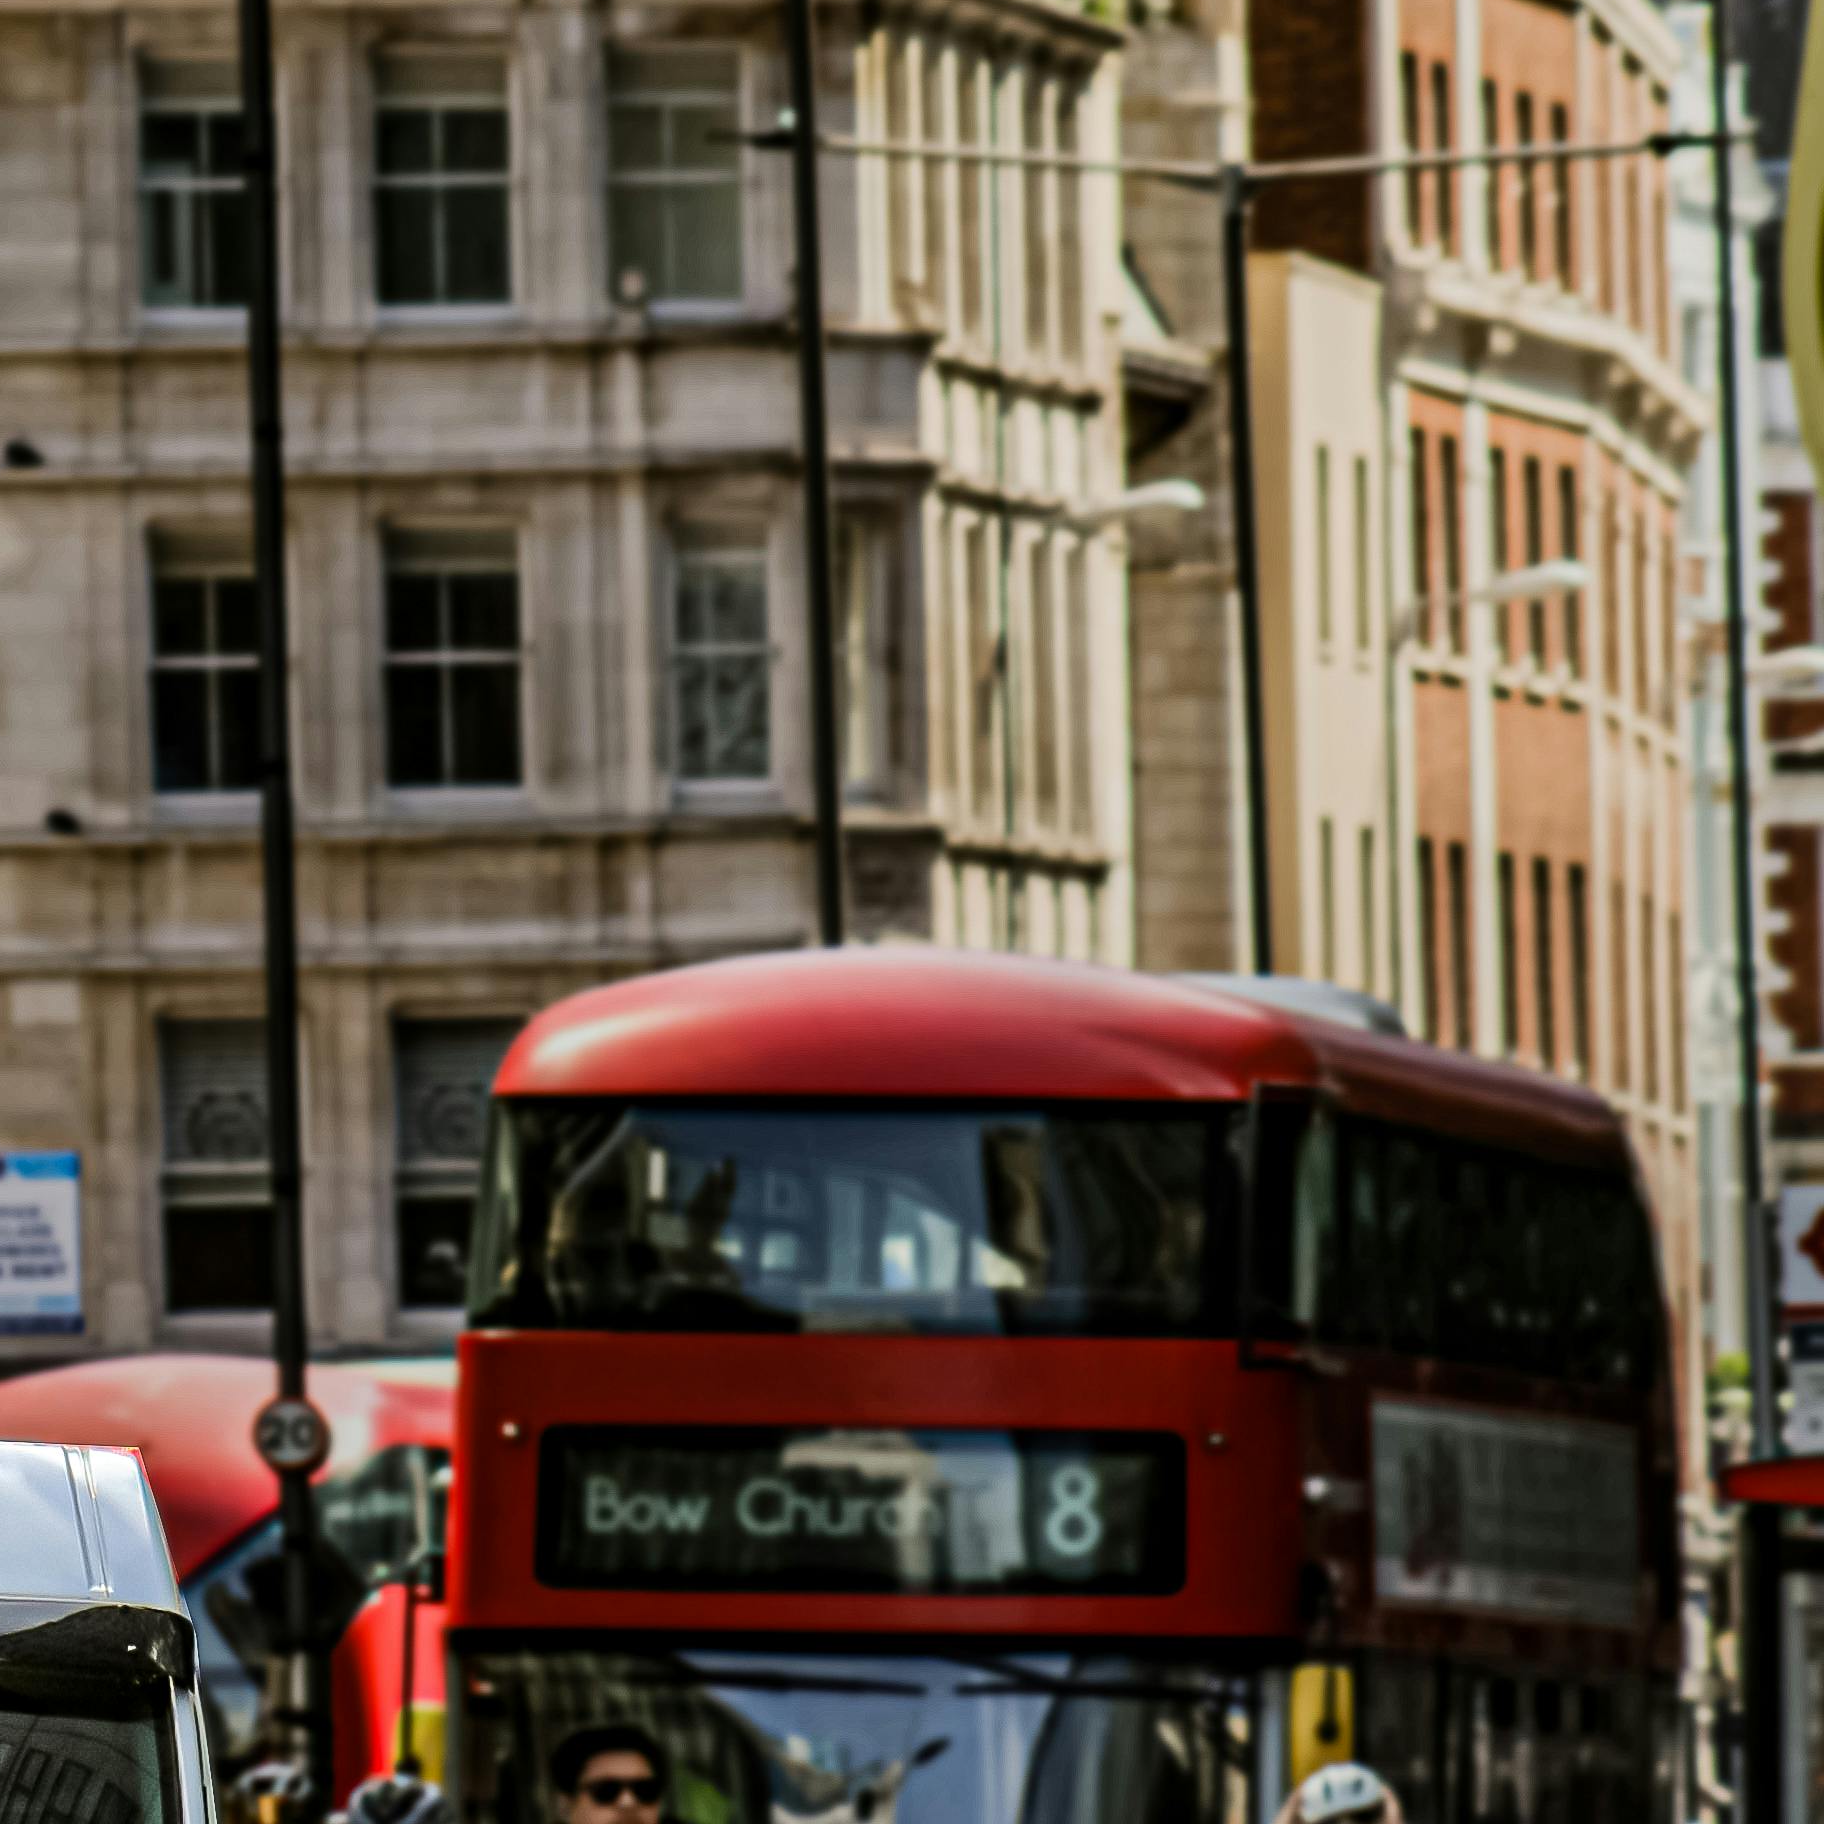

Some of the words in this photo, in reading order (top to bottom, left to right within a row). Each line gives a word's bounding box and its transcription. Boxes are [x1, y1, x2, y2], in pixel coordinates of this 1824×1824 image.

[261, 1413, 318, 1450] 20
[585, 1477, 709, 1535] Bow
[1045, 1463, 1103, 1556] 8
